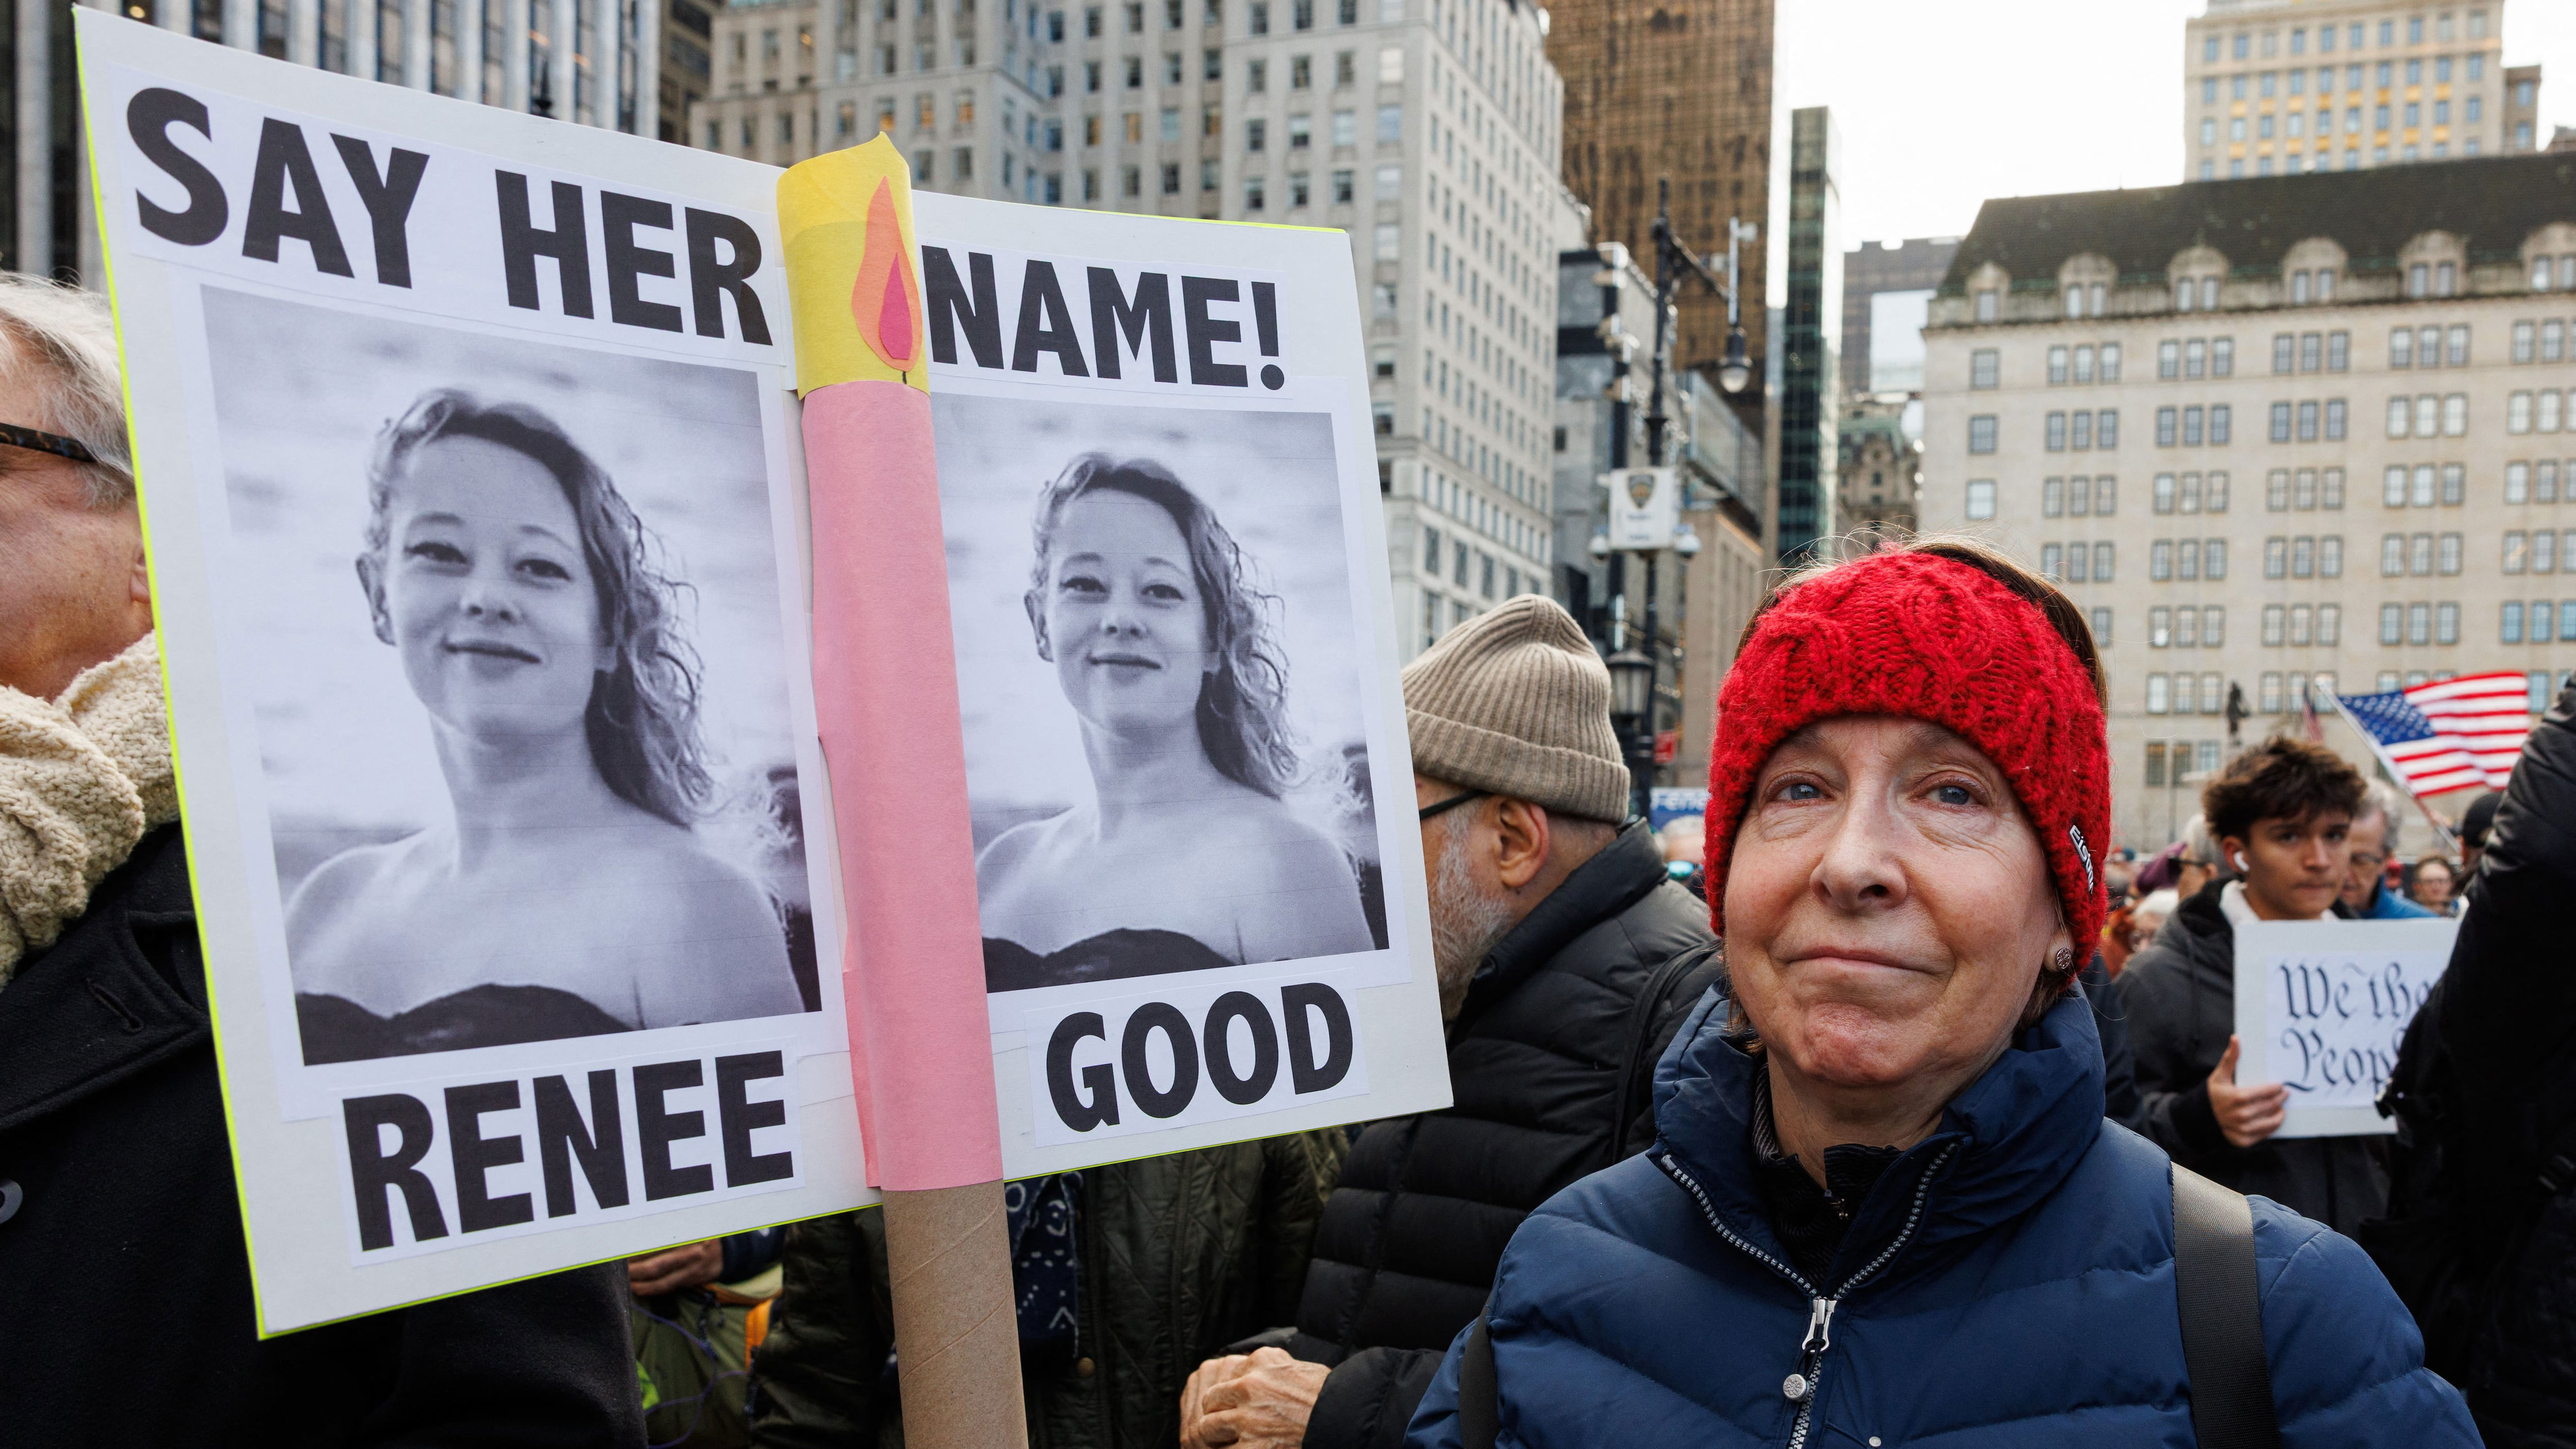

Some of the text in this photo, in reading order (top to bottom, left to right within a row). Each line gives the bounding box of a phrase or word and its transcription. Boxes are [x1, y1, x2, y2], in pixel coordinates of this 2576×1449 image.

[127, 87, 1285, 391] SAY HER NAME!
[344, 982, 1354, 1252] RENEE GOOD
[2280, 961, 2349, 1021] We
